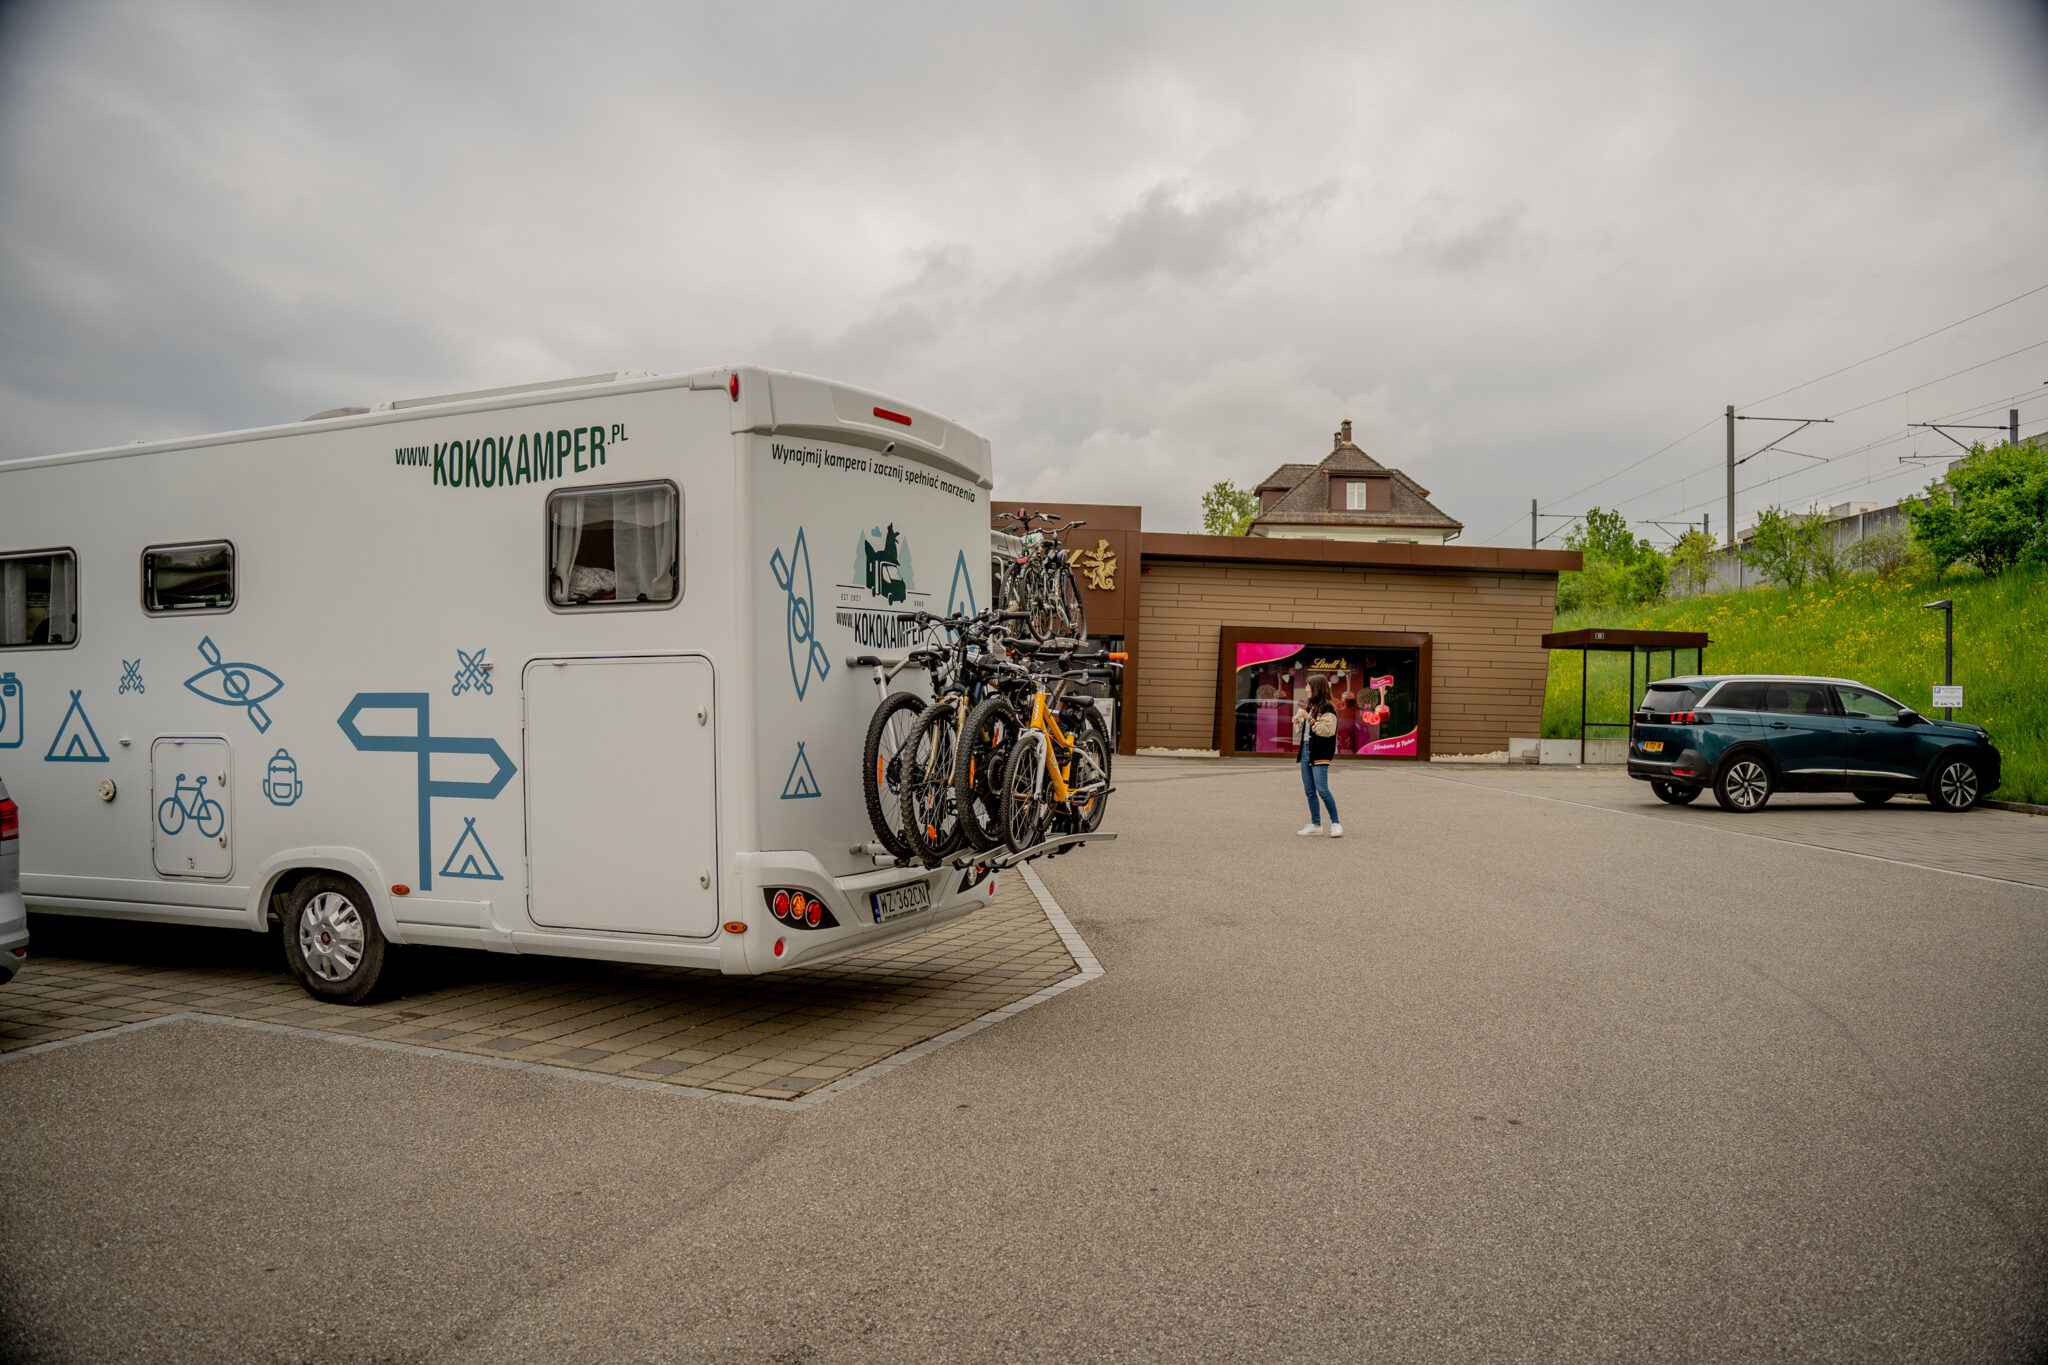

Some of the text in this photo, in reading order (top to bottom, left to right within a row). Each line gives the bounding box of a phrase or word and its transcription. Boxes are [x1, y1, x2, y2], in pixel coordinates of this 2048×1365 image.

[771, 443, 976, 503] Wynajmij kampera i zacznij spełniać marzenia
[879, 893, 895, 914] WZ
[895, 885, 926, 909] 362CN
